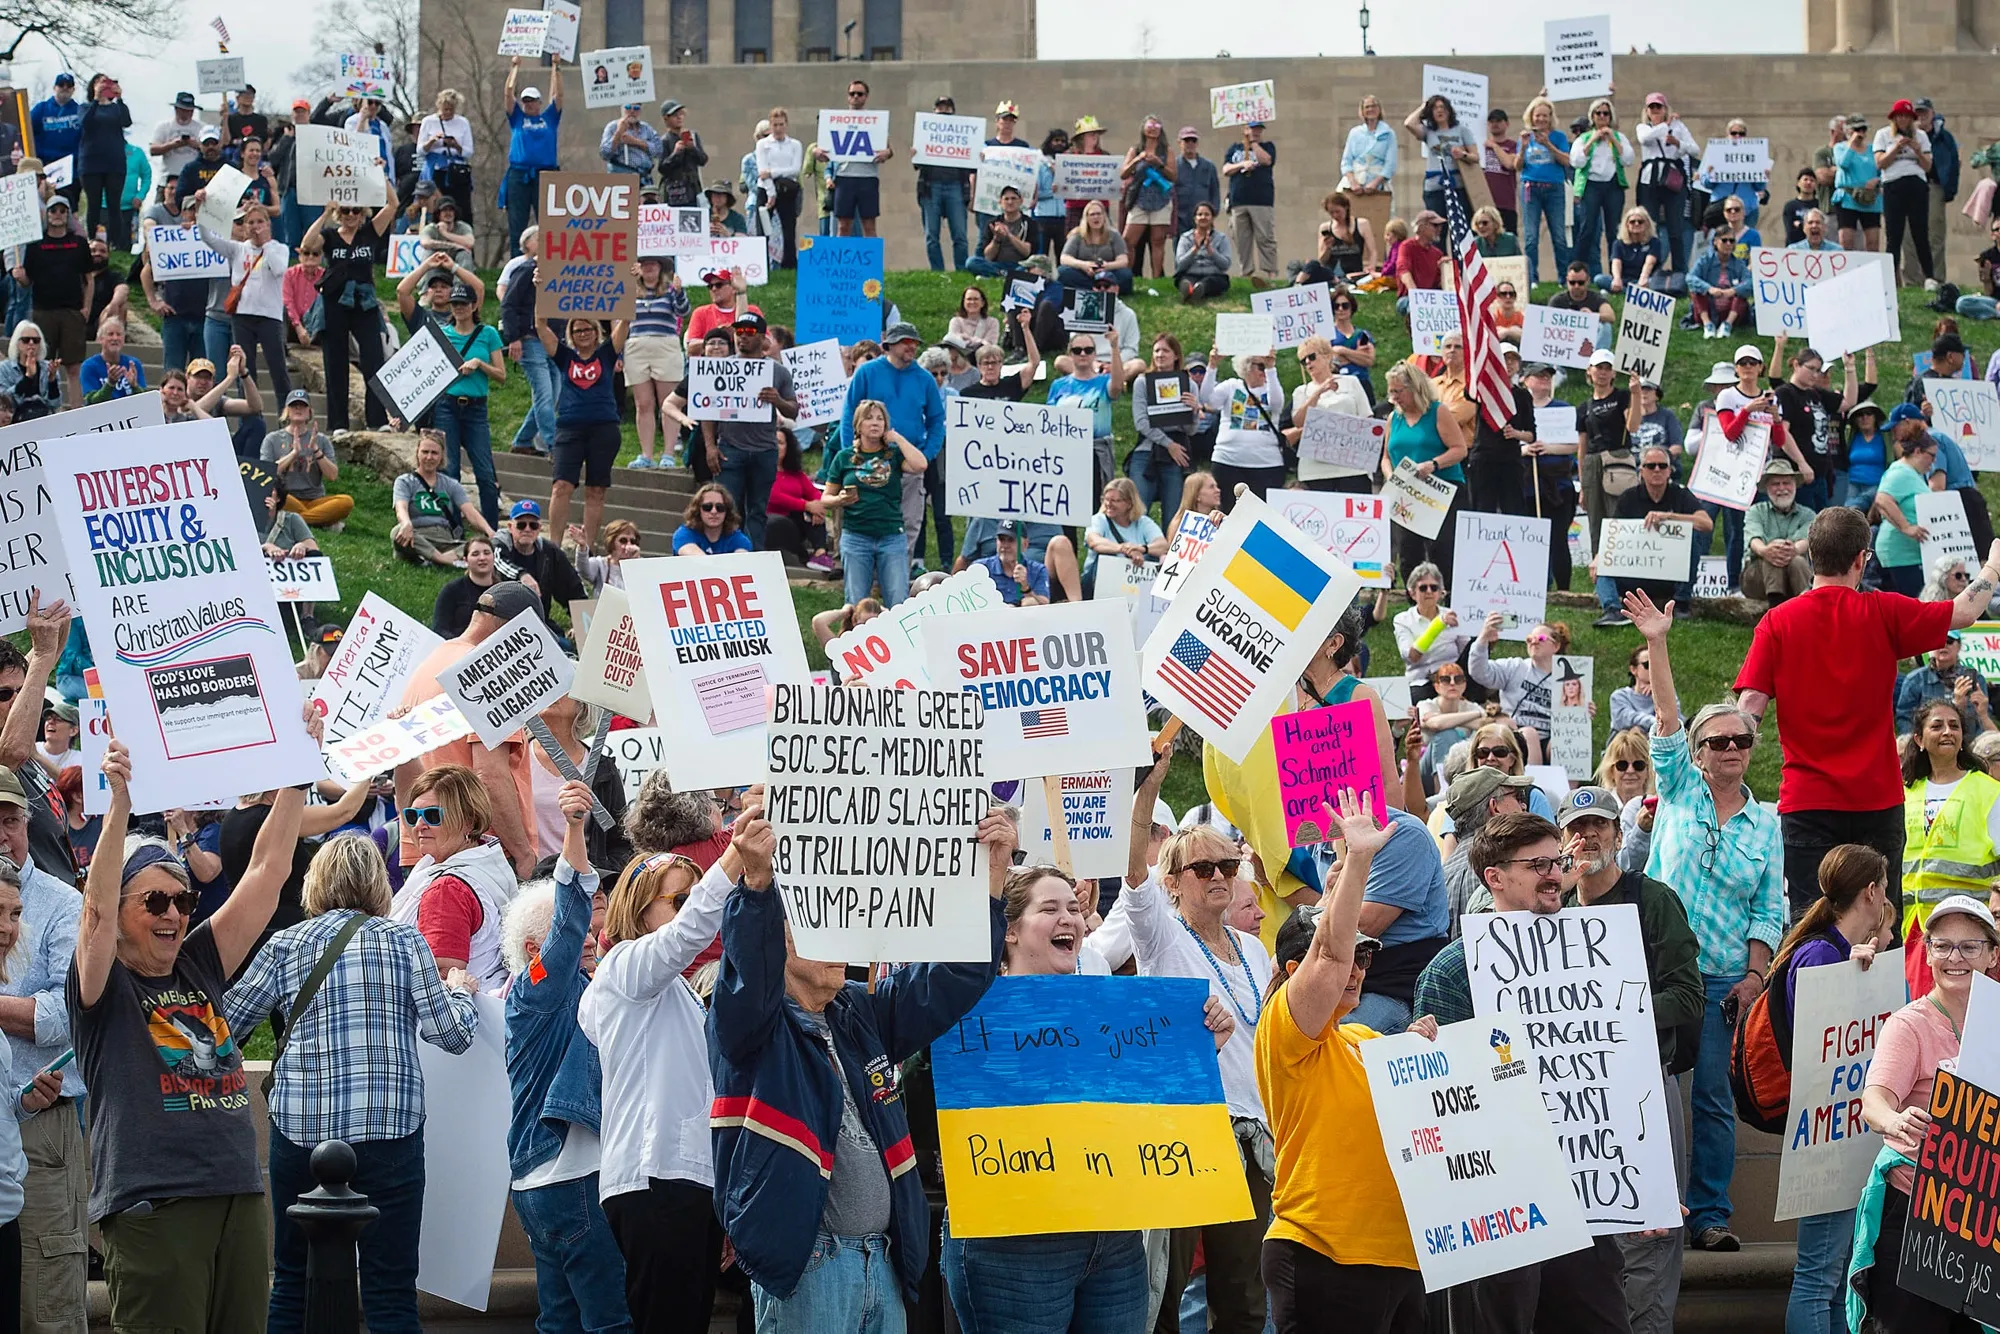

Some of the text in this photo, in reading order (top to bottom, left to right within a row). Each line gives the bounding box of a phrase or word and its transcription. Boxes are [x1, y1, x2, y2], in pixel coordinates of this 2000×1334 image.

[830, 115, 878, 125] PROTECT
[922, 120, 978, 135] EQUALITY
[830, 130, 874, 156] VA
[925, 144, 971, 157] NO ONE
[929, 133, 969, 146] HURTS
[1062, 160, 1118, 171] Democracy
[1724, 153, 1756, 163] DEFEND
[323, 165, 372, 178] ASSET
[335, 180, 356, 188] since
[1064, 177, 1114, 186] Spectator
[330, 188, 359, 203] 1987
[546, 183, 631, 219] LOVE
[566, 217, 608, 230] NOT
[637, 207, 670, 222] ELON
[154, 227, 187, 243] FIRE
[545, 231, 628, 262] HATE
[157, 252, 192, 269] SAVE
[809, 249, 874, 267] KANSAS
[560, 264, 616, 279] MAKES
[544, 278, 626, 297] AMERICA
[1626, 285, 1673, 316] HONK
[557, 296, 620, 313] GREAT
[809, 321, 869, 336] ZELENSKY
[1552, 312, 1590, 329] SMELL
[1623, 319, 1662, 347] RULE
[1543, 327, 1575, 343] DOGE
[384, 338, 431, 386] Diversity
[697, 360, 766, 376] HANDS OFF
[785, 351, 827, 366] We the
[1621, 353, 1656, 379] LAW
[399, 357, 450, 411] Strength!
[412, 366, 423, 379] is
[714, 376, 747, 391] OUR
[954, 400, 1088, 440] I've Seen Better
[964, 440, 1065, 477] Cabinets
[74, 457, 219, 513] DIVERSITY,
[957, 478, 1070, 517] AT IKEA
[83, 503, 207, 552] EQUITY &
[1335, 527, 1375, 547] Russia
[1460, 515, 1548, 545] Thank You
[1606, 535, 1663, 552] SOCIAL
[94, 537, 238, 589] INCLUSION
[1482, 540, 1520, 583] A
[1603, 551, 1666, 569] SECURITY
[1467, 579, 1490, 594] The
[112, 593, 151, 620] ARE
[659, 574, 764, 629] FIRE
[670, 619, 767, 647] UNELECTED
[1206, 588, 1285, 655] SUPPORT
[676, 637, 773, 666] ELON MUSK
[1195, 603, 1274, 674] UKRAINE
[1972, 640, 1984, 651] is
[457, 627, 534, 692] AMERICANS
[842, 635, 891, 681] NO
[957, 631, 1108, 680] SAVE OUR
[151, 664, 216, 688] GOD'S LOVE
[153, 673, 256, 702] HAS NO BORDERS
[481, 658, 537, 703] AGAINST
[603, 664, 635, 689] CUTS
[697, 668, 760, 689] NOTICE OF TERMINATION
[486, 669, 560, 729] OLIGARCHY
[962, 670, 1112, 711] EMOCRACY
[163, 718, 175, 728] We
[175, 714, 196, 728] support
[196, 715, 207, 723] our
[207, 709, 234, 722] immigrant
[773, 683, 985, 731] BILLIONAIRE GREED
[1551, 711, 1588, 725] Wicked
[1284, 713, 1353, 745] Hawley
[340, 732, 387, 758] NO
[1310, 733, 1341, 753] and
[353, 746, 402, 772] NO
[1281, 751, 1358, 789] Schmidt
[766, 785, 991, 829] MEDICAID SLASHED
[1083, 795, 1106, 808] ARE
[1286, 793, 1318, 817] are
[1095, 811, 1106, 823] IT
[1082, 826, 1113, 839] NOW.
[797, 836, 979, 878] TRILLION DEBT
[1488, 916, 1612, 985] SUPER
[1496, 979, 1604, 1016] CALLOUS
[954, 1015, 1171, 1060] It was "just"
[1522, 1020, 1629, 1050] RAGILE
[1822, 1012, 1891, 1064] FIGHT
[1387, 1050, 1450, 1088] DEFUND
[1492, 1066, 1528, 1082] UKRAINE
[1494, 1058, 1526, 1073] STAND WITH
[1538, 1050, 1615, 1084] ACIST
[1431, 1083, 1481, 1119] DOGE
[1411, 1126, 1444, 1158] FIRE
[968, 1133, 1218, 1178] Poland in 1939...
[1446, 1149, 1497, 1182] MUSK
[1424, 1202, 1548, 1256] SAVE AMERICA
[1905, 1229, 1965, 1283] Makes
